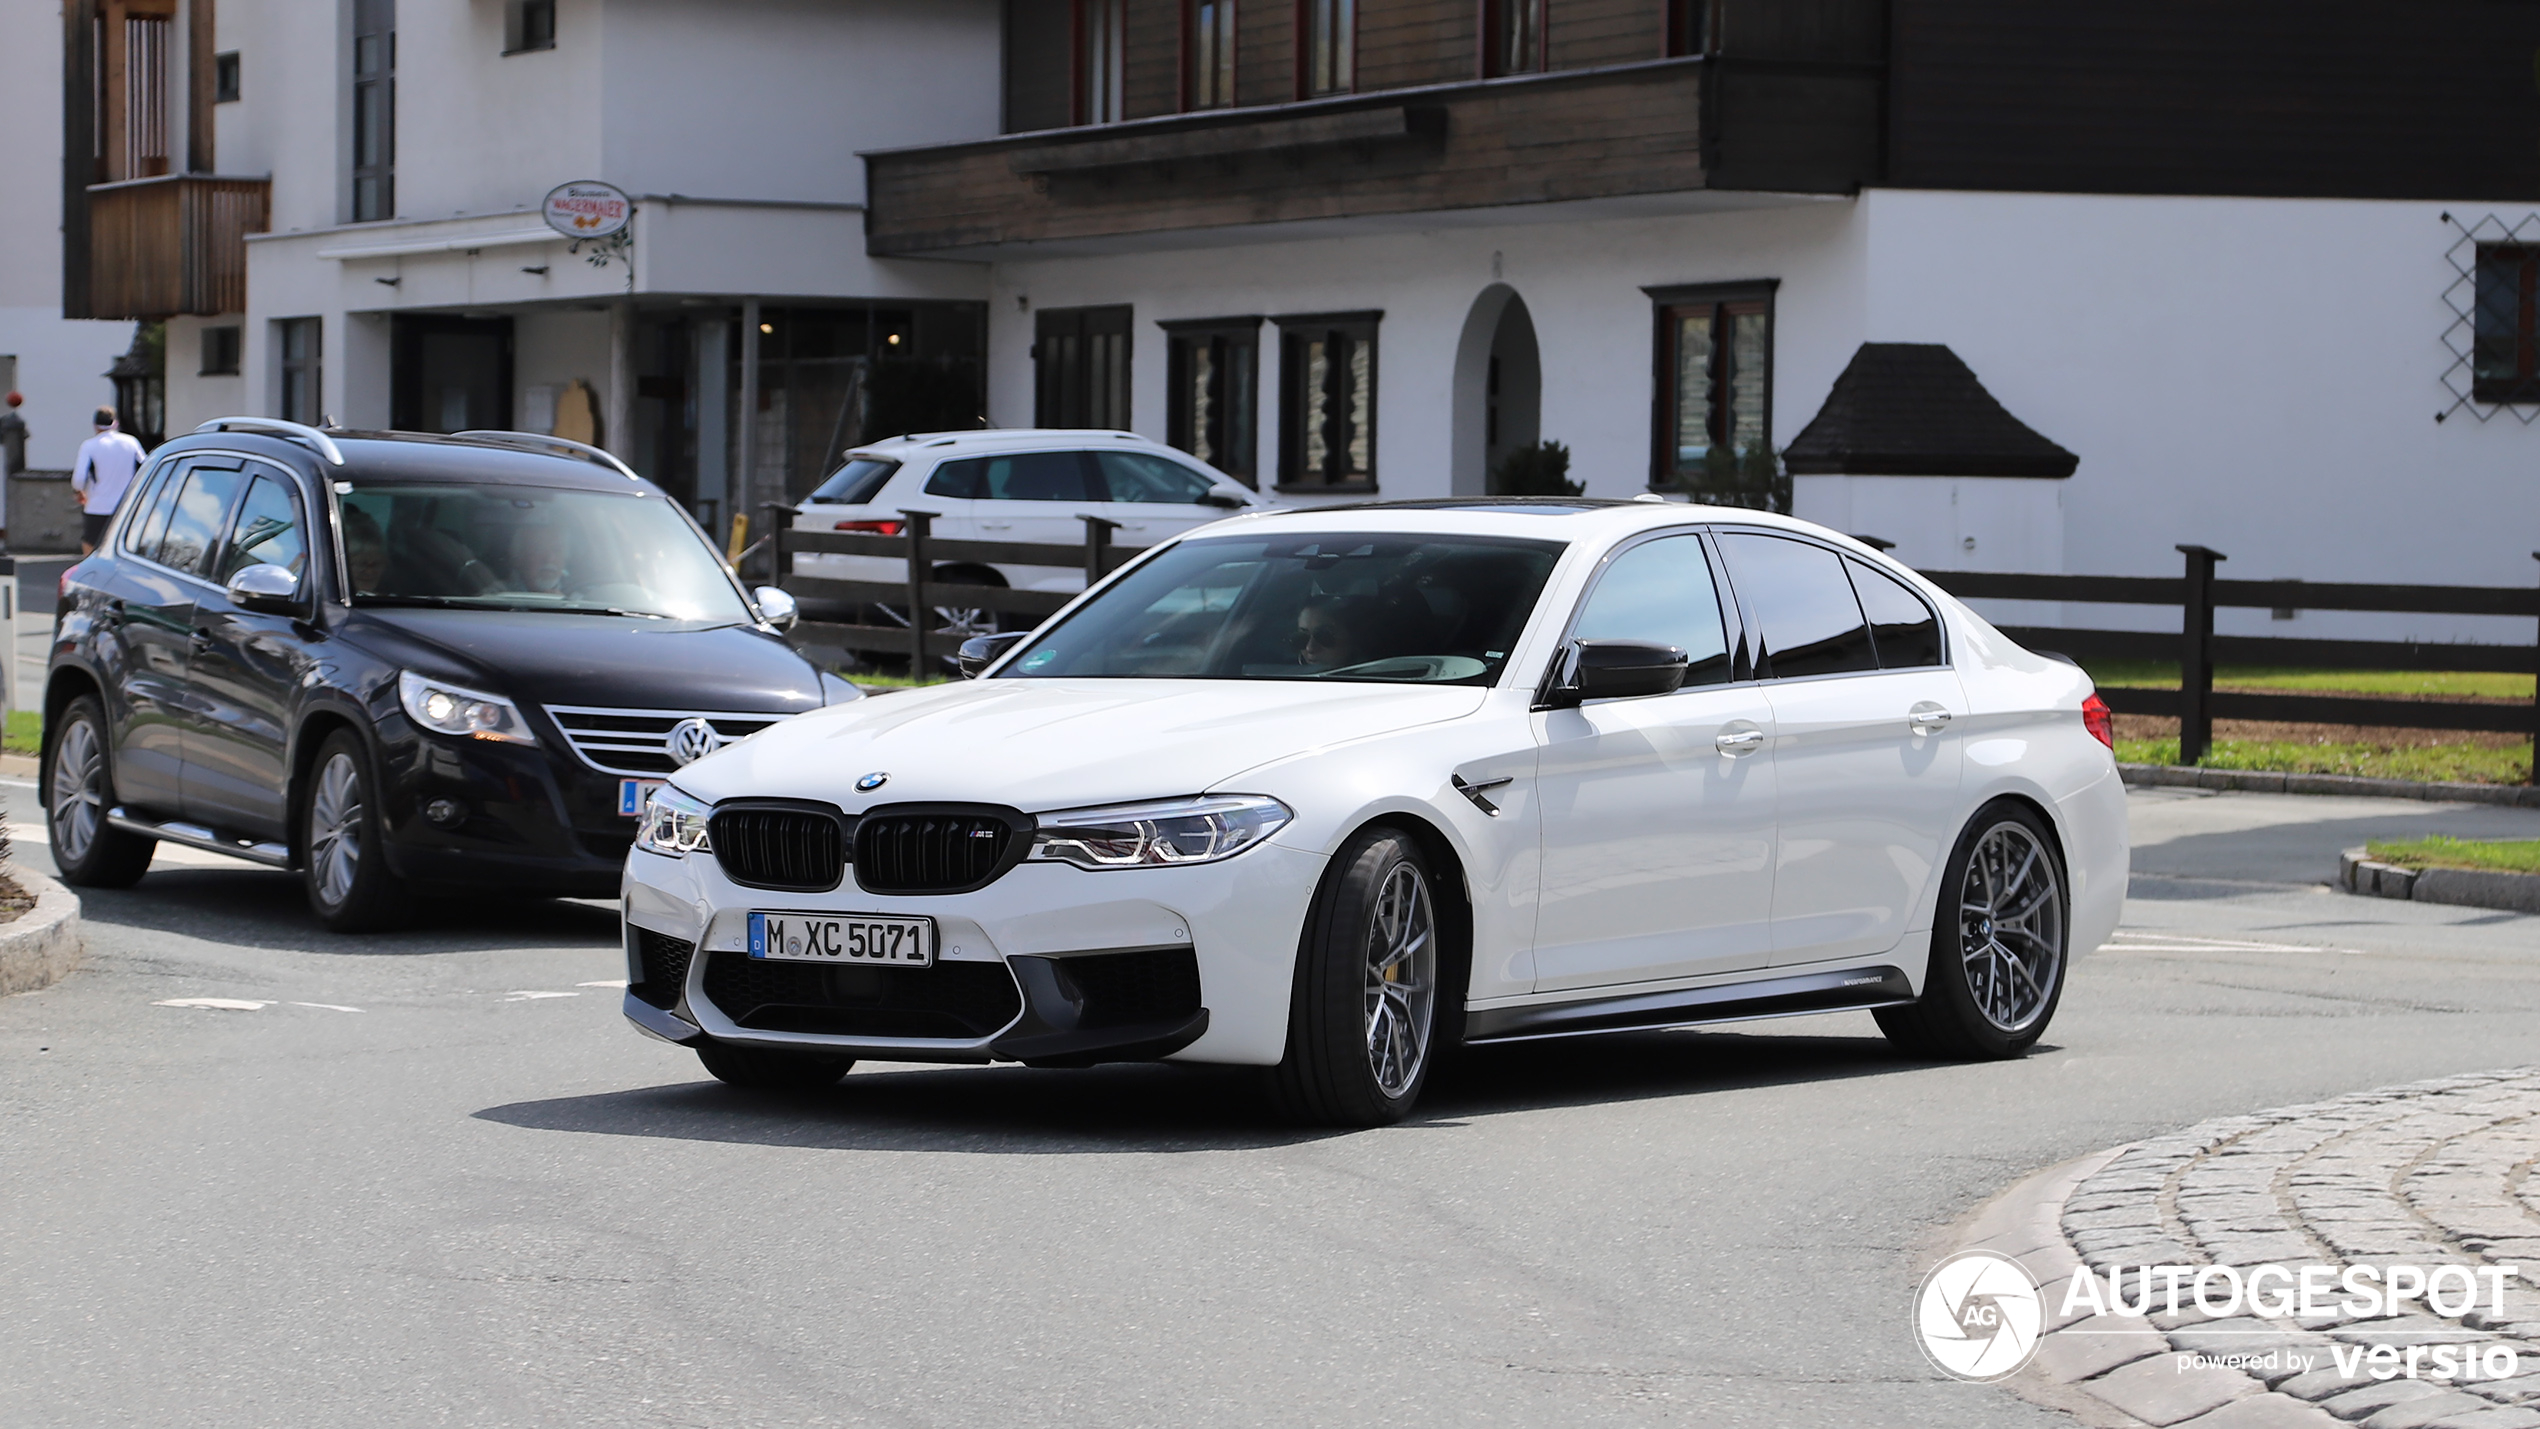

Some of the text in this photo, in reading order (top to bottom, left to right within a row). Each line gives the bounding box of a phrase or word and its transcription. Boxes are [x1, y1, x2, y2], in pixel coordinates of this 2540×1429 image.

[754, 940, 760, 950] D
[766, 919, 925, 960] M XC 5071
